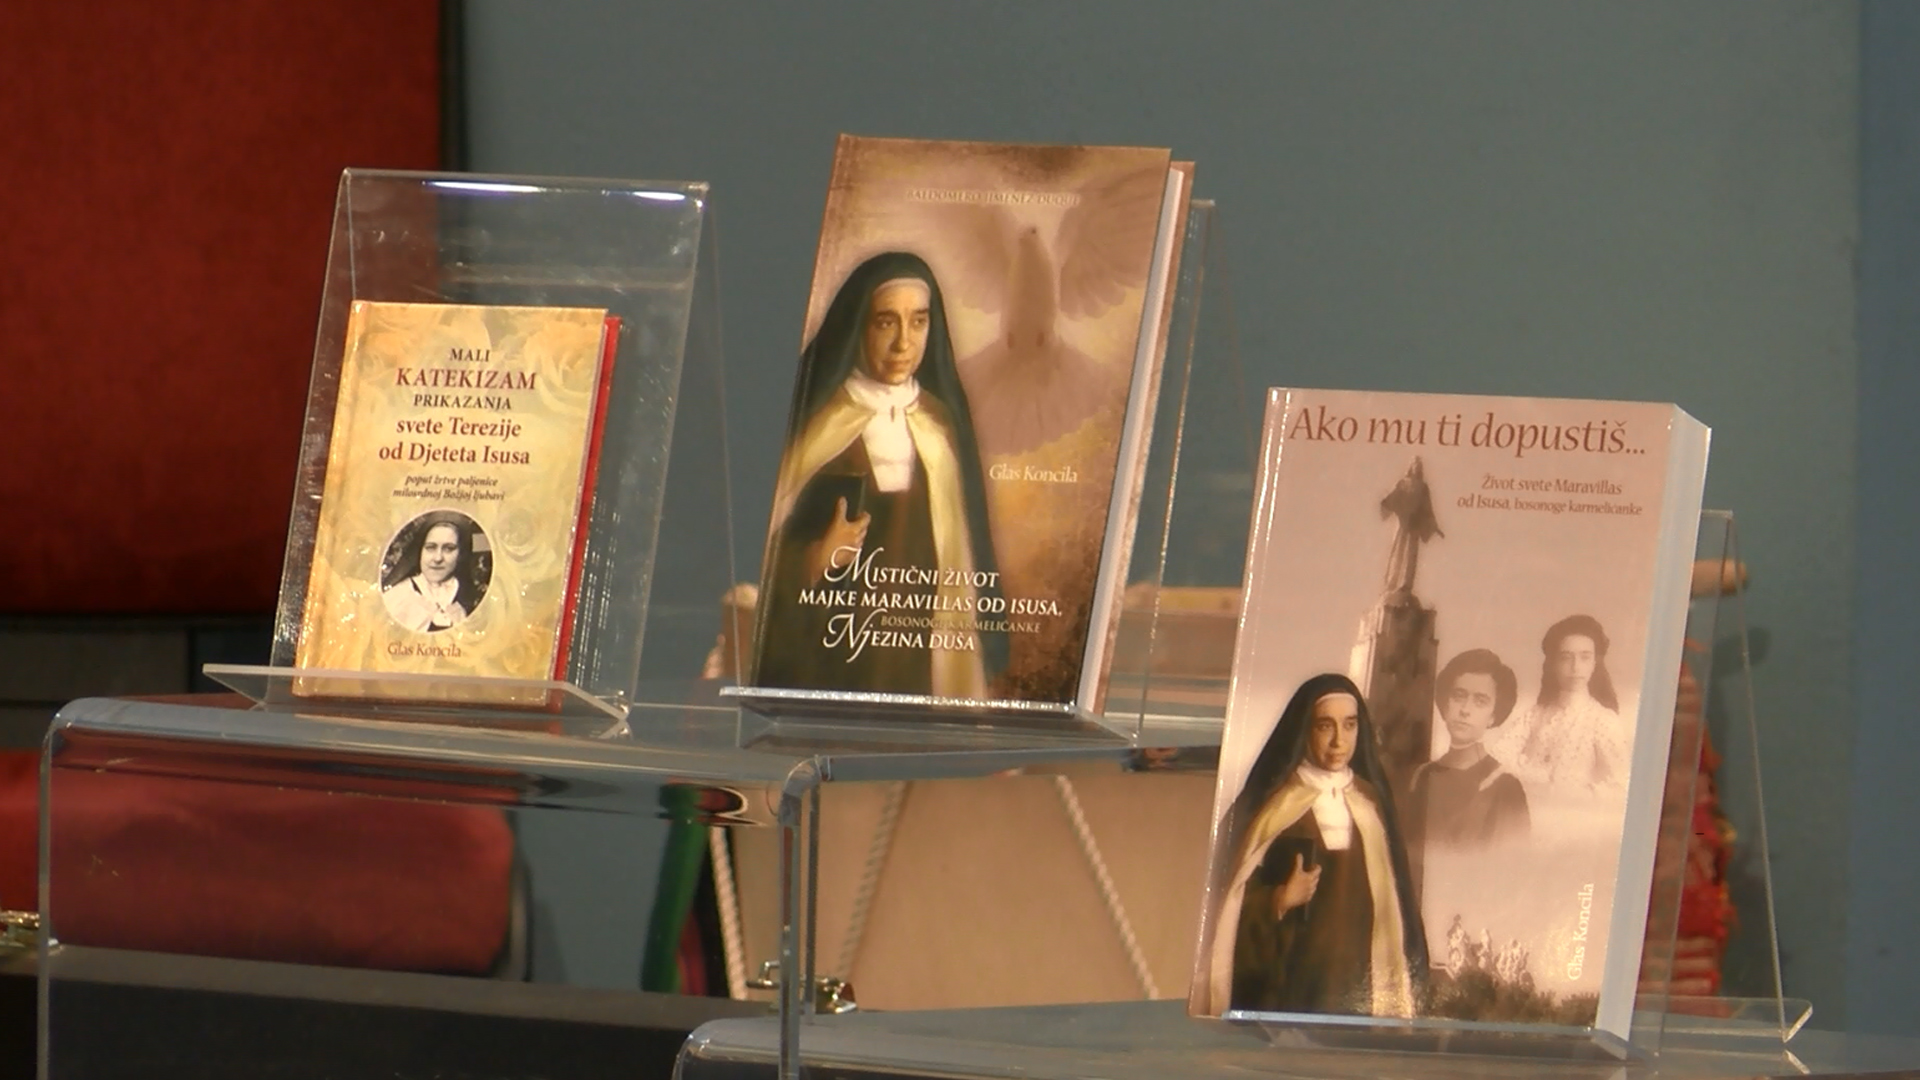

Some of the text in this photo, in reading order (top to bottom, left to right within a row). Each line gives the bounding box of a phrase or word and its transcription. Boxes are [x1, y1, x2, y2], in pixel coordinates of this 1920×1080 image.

[450, 348, 490, 363] MALI
[396, 367, 537, 390] KATEKIZAM
[413, 393, 512, 411] PRIKAZANJA
[396, 416, 522, 442] svete Terezije
[1289, 406, 1646, 459] Ako mu ti dopustiš...
[378, 441, 530, 467] od Djeteta Isusa
[405, 475, 433, 486] poput
[989, 463, 1078, 483] Glas Koncila
[1481, 473, 1623, 496] Život svete Maravillas
[1457, 493, 1475, 509] od
[1514, 499, 1567, 514] bosonoge
[824, 545, 999, 590] MISTIČNI ŽIVOT
[798, 588, 1063, 618] MAJKE MARAVILLAS OD ISUSA,
[388, 642, 462, 658] Glas Koncila
[929, 631, 975, 651] DUŠA
[1567, 883, 1594, 981] Glas Koncila
